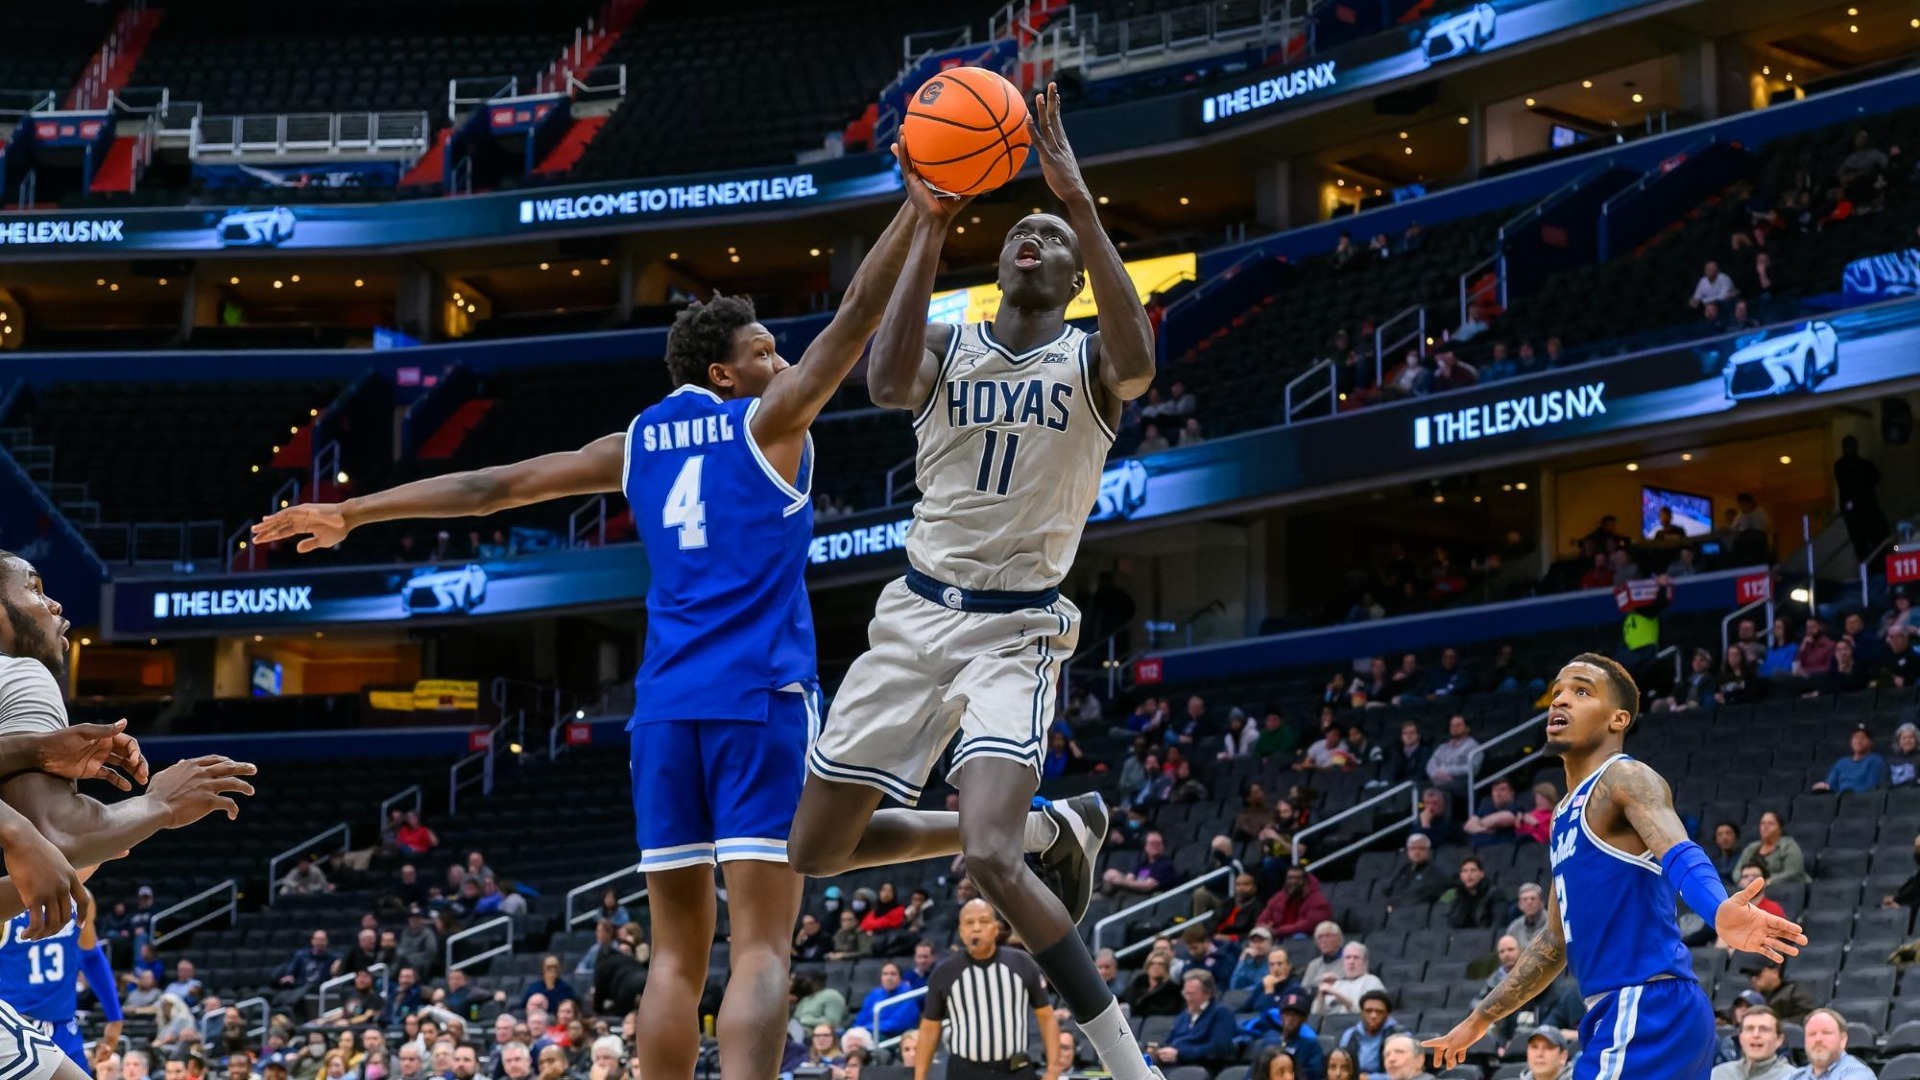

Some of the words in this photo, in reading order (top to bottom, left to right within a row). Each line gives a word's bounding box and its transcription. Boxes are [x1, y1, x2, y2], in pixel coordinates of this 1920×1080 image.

[1217, 86, 1250, 118] THE
[1250, 69, 1306, 108] LEXUS
[1307, 60, 1336, 91] NX
[536, 191, 638, 221] WELCOME
[639, 188, 668, 212] TO
[668, 185, 706, 209] THE
[707, 180, 760, 206] NEXT
[761, 173, 818, 201] LEVEL
[0, 222, 26, 244] HE
[27, 221, 91, 243] LEXUS
[91, 219, 123, 241] NX
[946, 379, 1073, 433] HOYAS
[1433, 407, 1481, 444] THE
[1482, 391, 1564, 436] LEXUS
[1565, 382, 1606, 420] NX
[643, 413, 734, 452] SAMUEL
[975, 428, 1020, 497] 11
[662, 454, 709, 550] 4
[828, 532, 853, 560] TO
[852, 524, 886, 556] THE
[885, 519, 914, 550] NE
[1894, 558, 1918, 577] 111
[171, 591, 210, 617] THE
[211, 587, 278, 615] LEXUS
[278, 586, 312, 612] NX
[942, 586, 963, 609] G
[28, 942, 64, 985] 13
